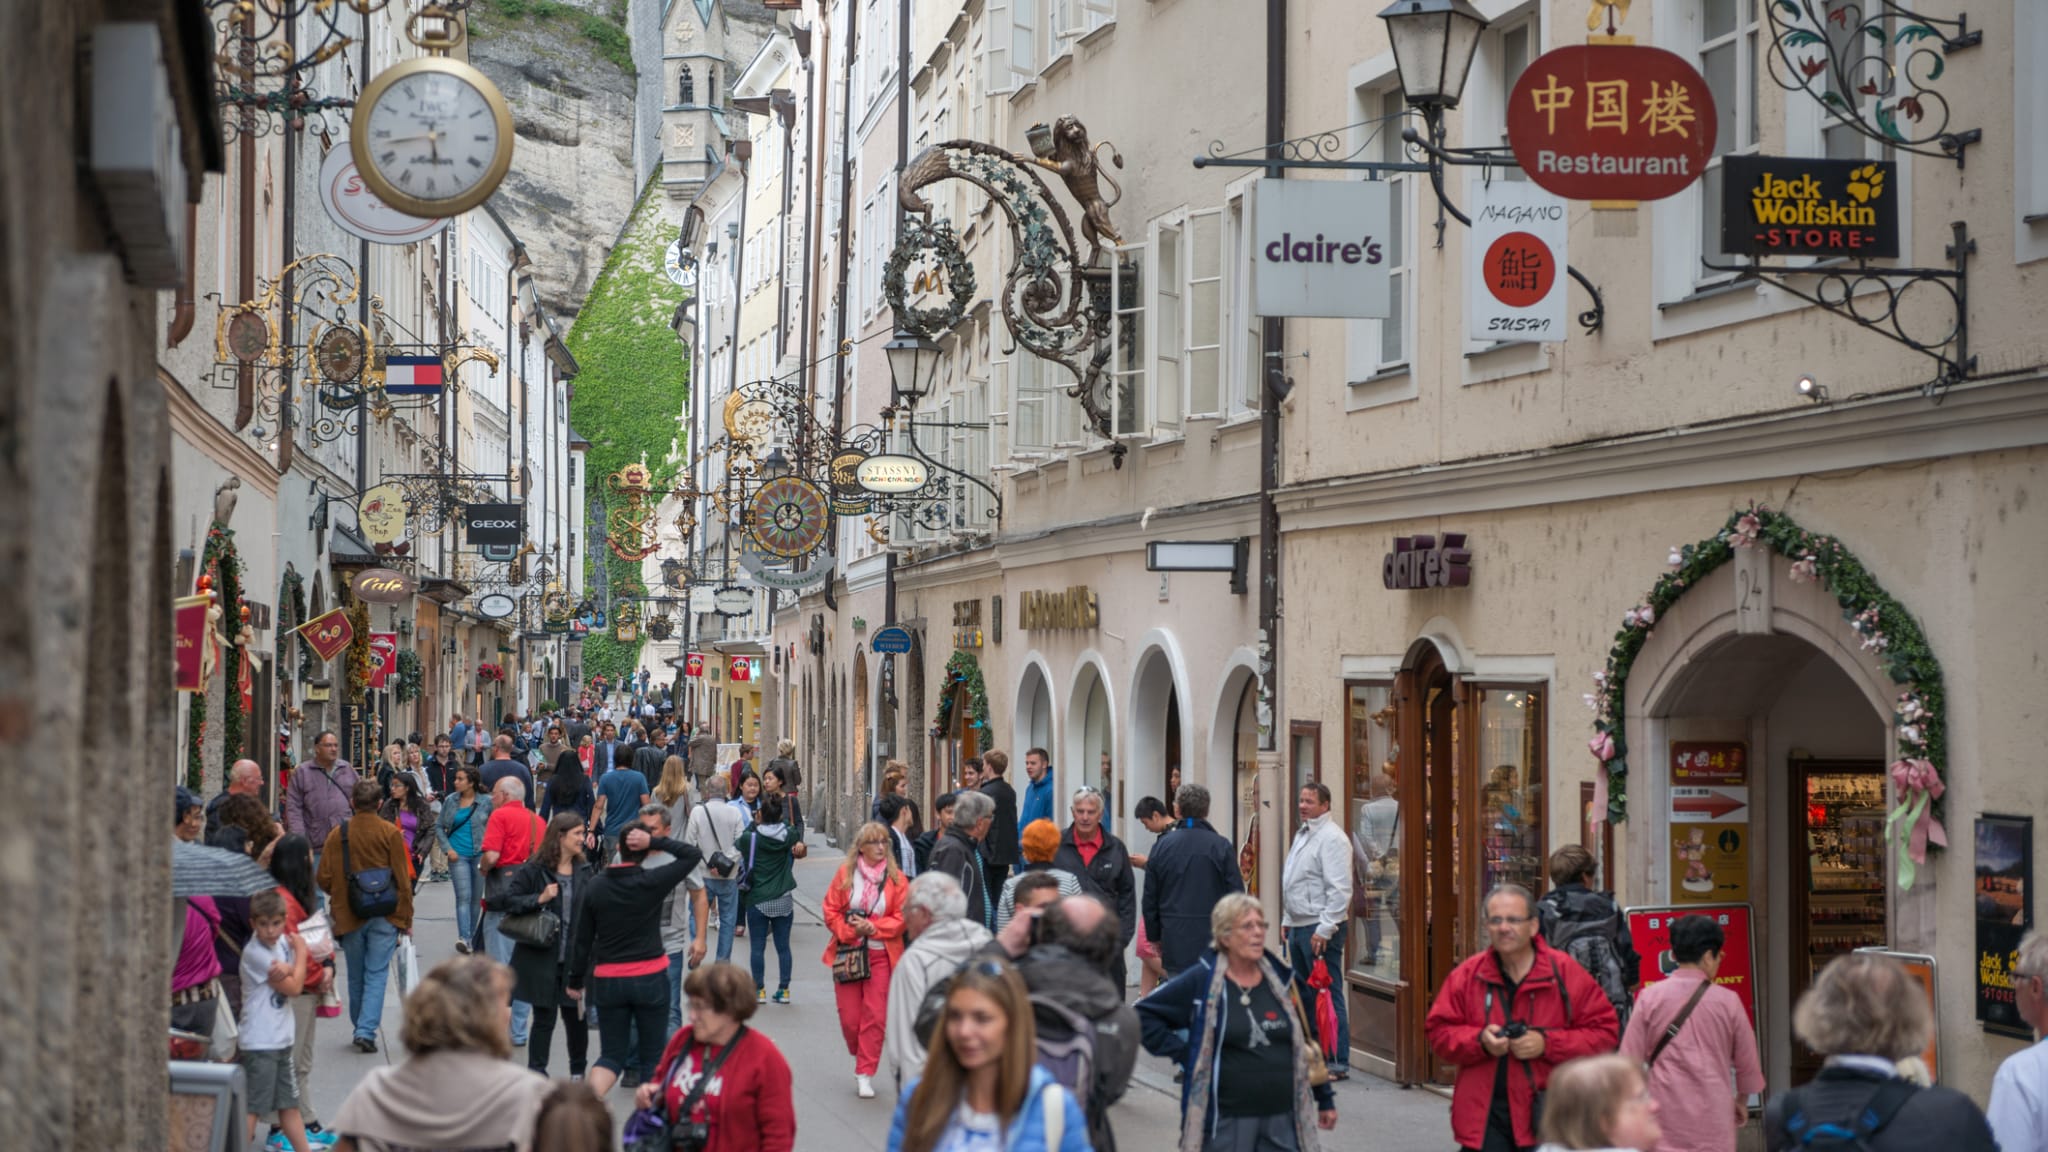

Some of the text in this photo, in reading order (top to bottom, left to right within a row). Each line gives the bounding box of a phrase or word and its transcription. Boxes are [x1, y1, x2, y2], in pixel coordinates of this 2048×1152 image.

[1530, 74, 1696, 139] 中国楼
[1537, 150, 1690, 176] Restaurant
[1752, 172, 1822, 200] Jack
[1479, 205, 1563, 224] NAGANO
[1753, 199, 1876, 226] Wolfskin
[1265, 233, 1383, 265] claire's
[1487, 317, 1551, 332] SUSHI
[866, 465, 918, 475] STASSNY
[471, 519, 517, 529] GEOX
[360, 577, 404, 593] Café
[754, 569, 823, 586] Aschauer
[1740, 567, 1762, 613] 24
[1980, 951, 2002, 969] Jack
